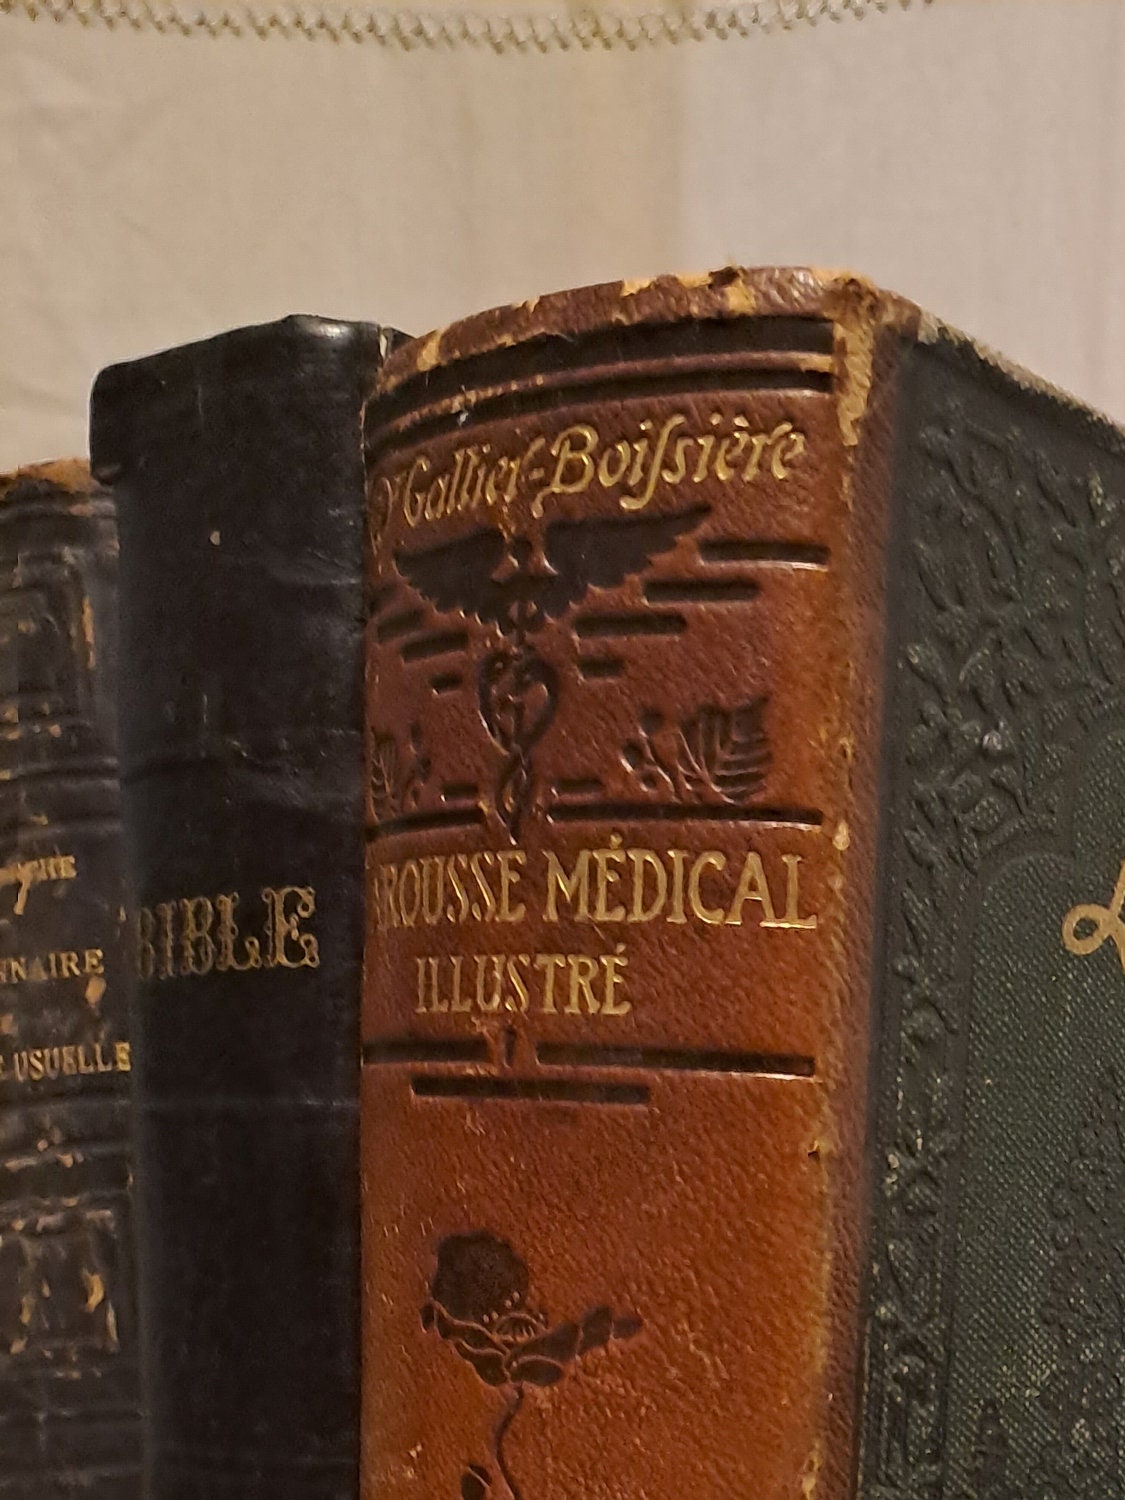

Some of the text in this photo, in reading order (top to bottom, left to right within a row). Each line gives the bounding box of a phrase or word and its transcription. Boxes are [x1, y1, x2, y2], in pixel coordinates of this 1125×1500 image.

[373, 832, 819, 933] ROUSSE MÉDICAL
[415, 942, 633, 1016] ILLUSTRÉ
